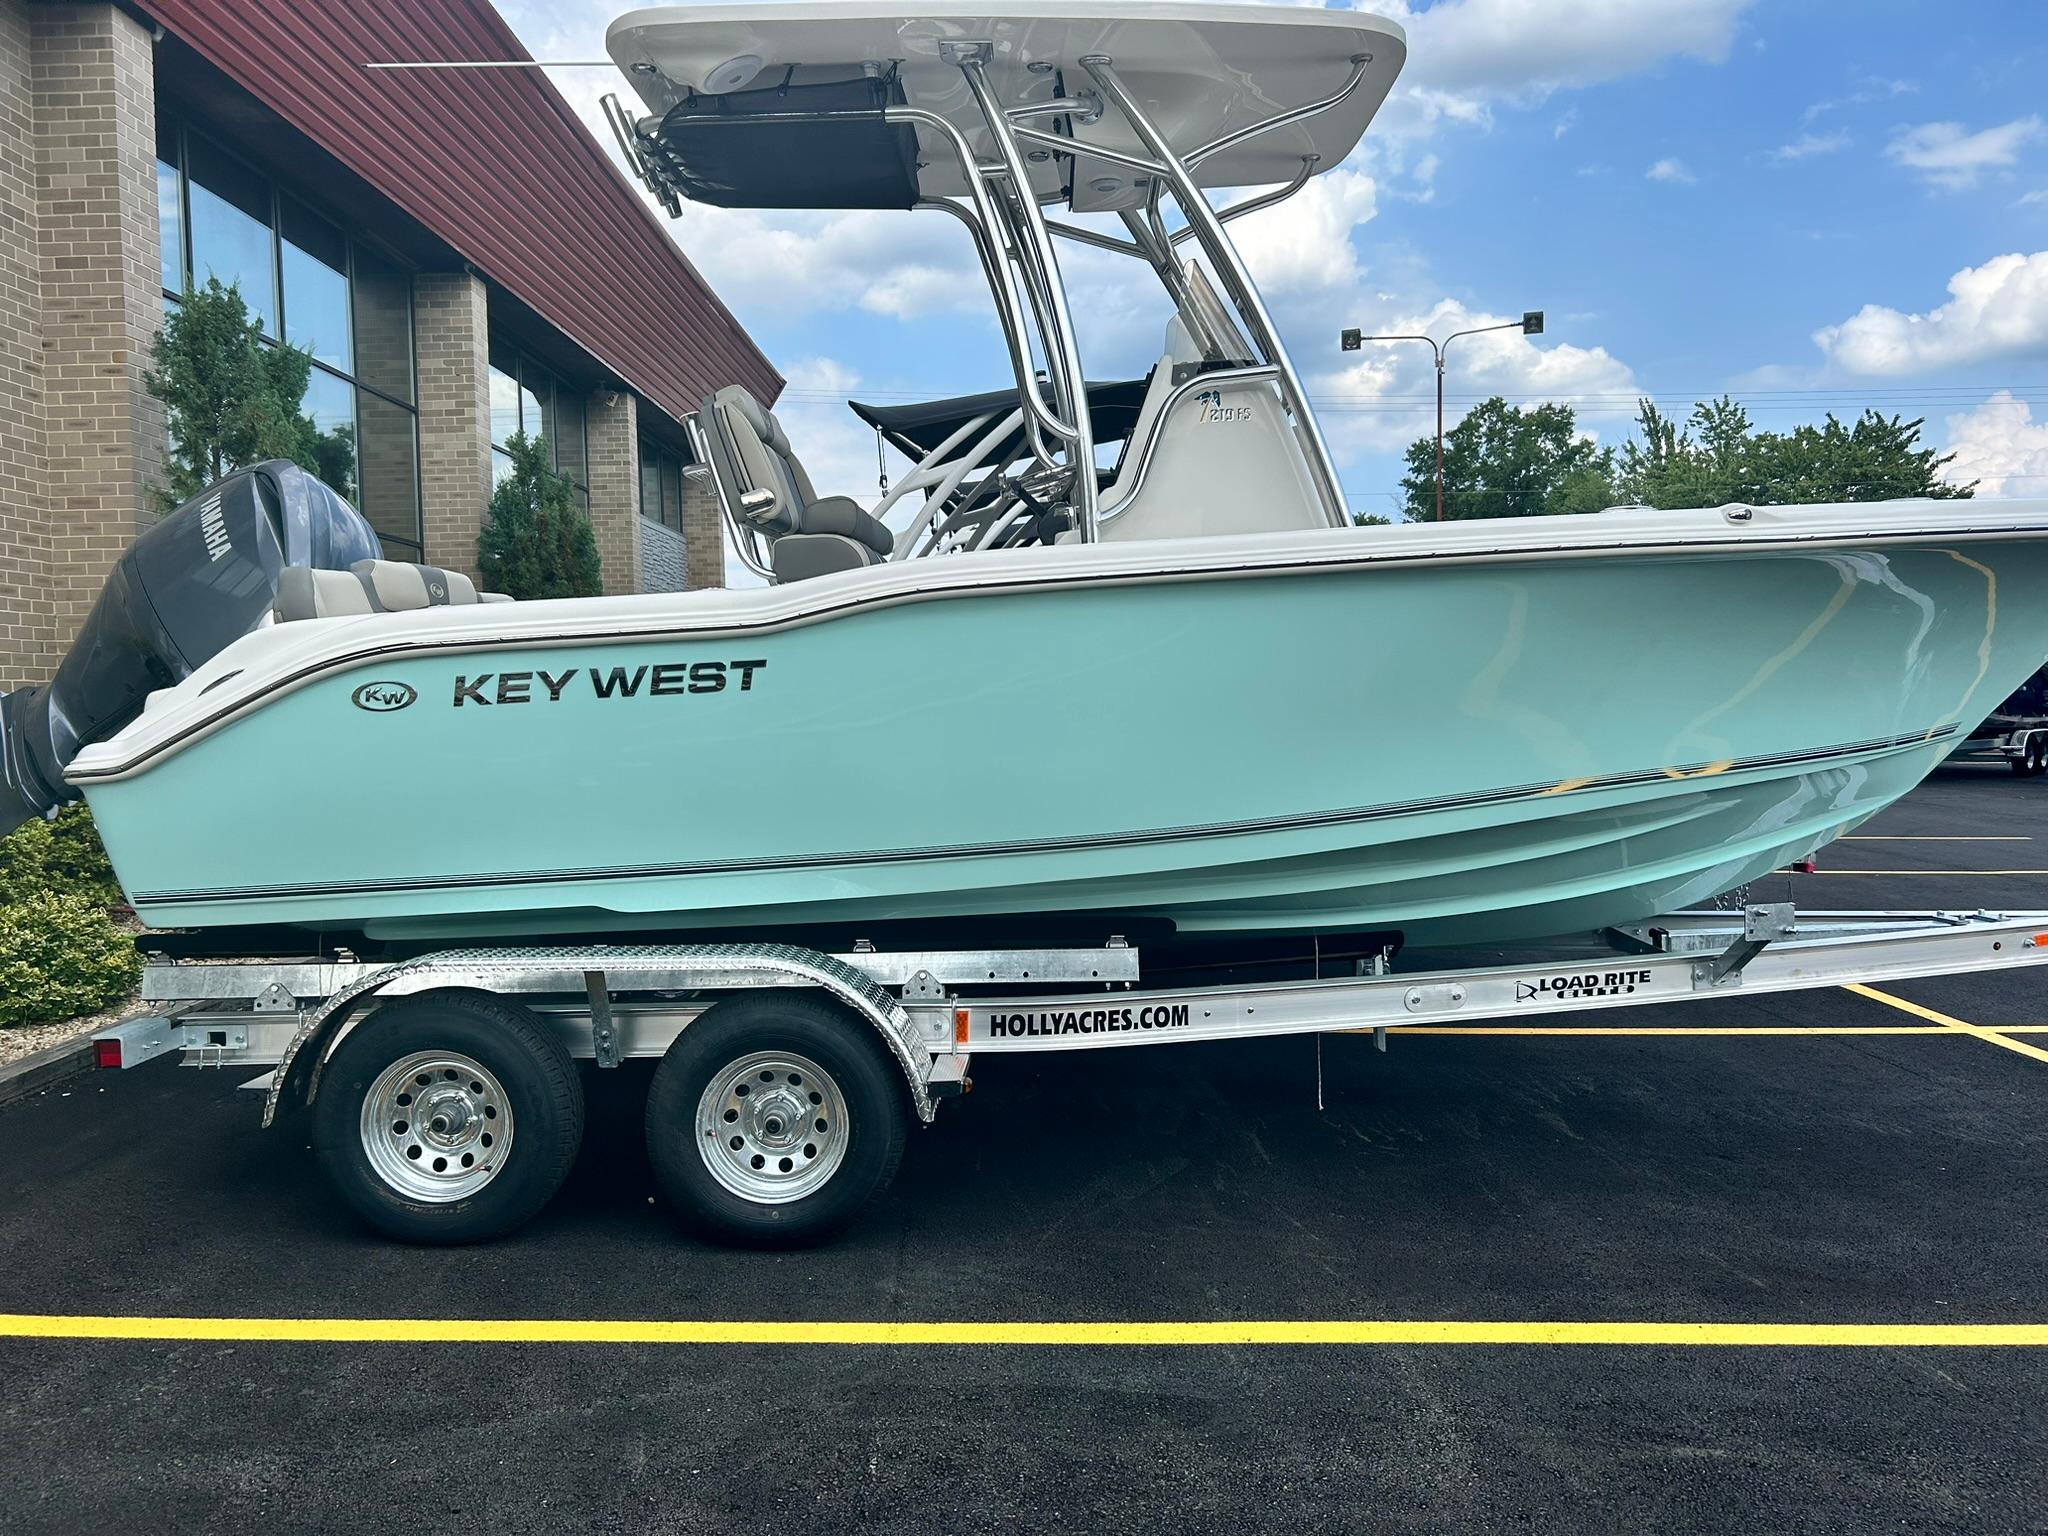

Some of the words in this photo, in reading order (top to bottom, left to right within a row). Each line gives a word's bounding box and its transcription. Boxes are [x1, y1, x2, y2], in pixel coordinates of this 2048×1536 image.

[1238, 407, 1252, 421] FS
[200, 492, 232, 562] YAMAHA
[453, 669, 579, 707] KEY
[589, 659, 767, 699] WEST
[364, 687, 408, 706] KW
[1539, 974, 1599, 992] LOAD
[1604, 969, 1652, 987] RITE
[1563, 985, 1629, 998] ELITE
[990, 1004, 1190, 1037] HOLLYACRES.COM
